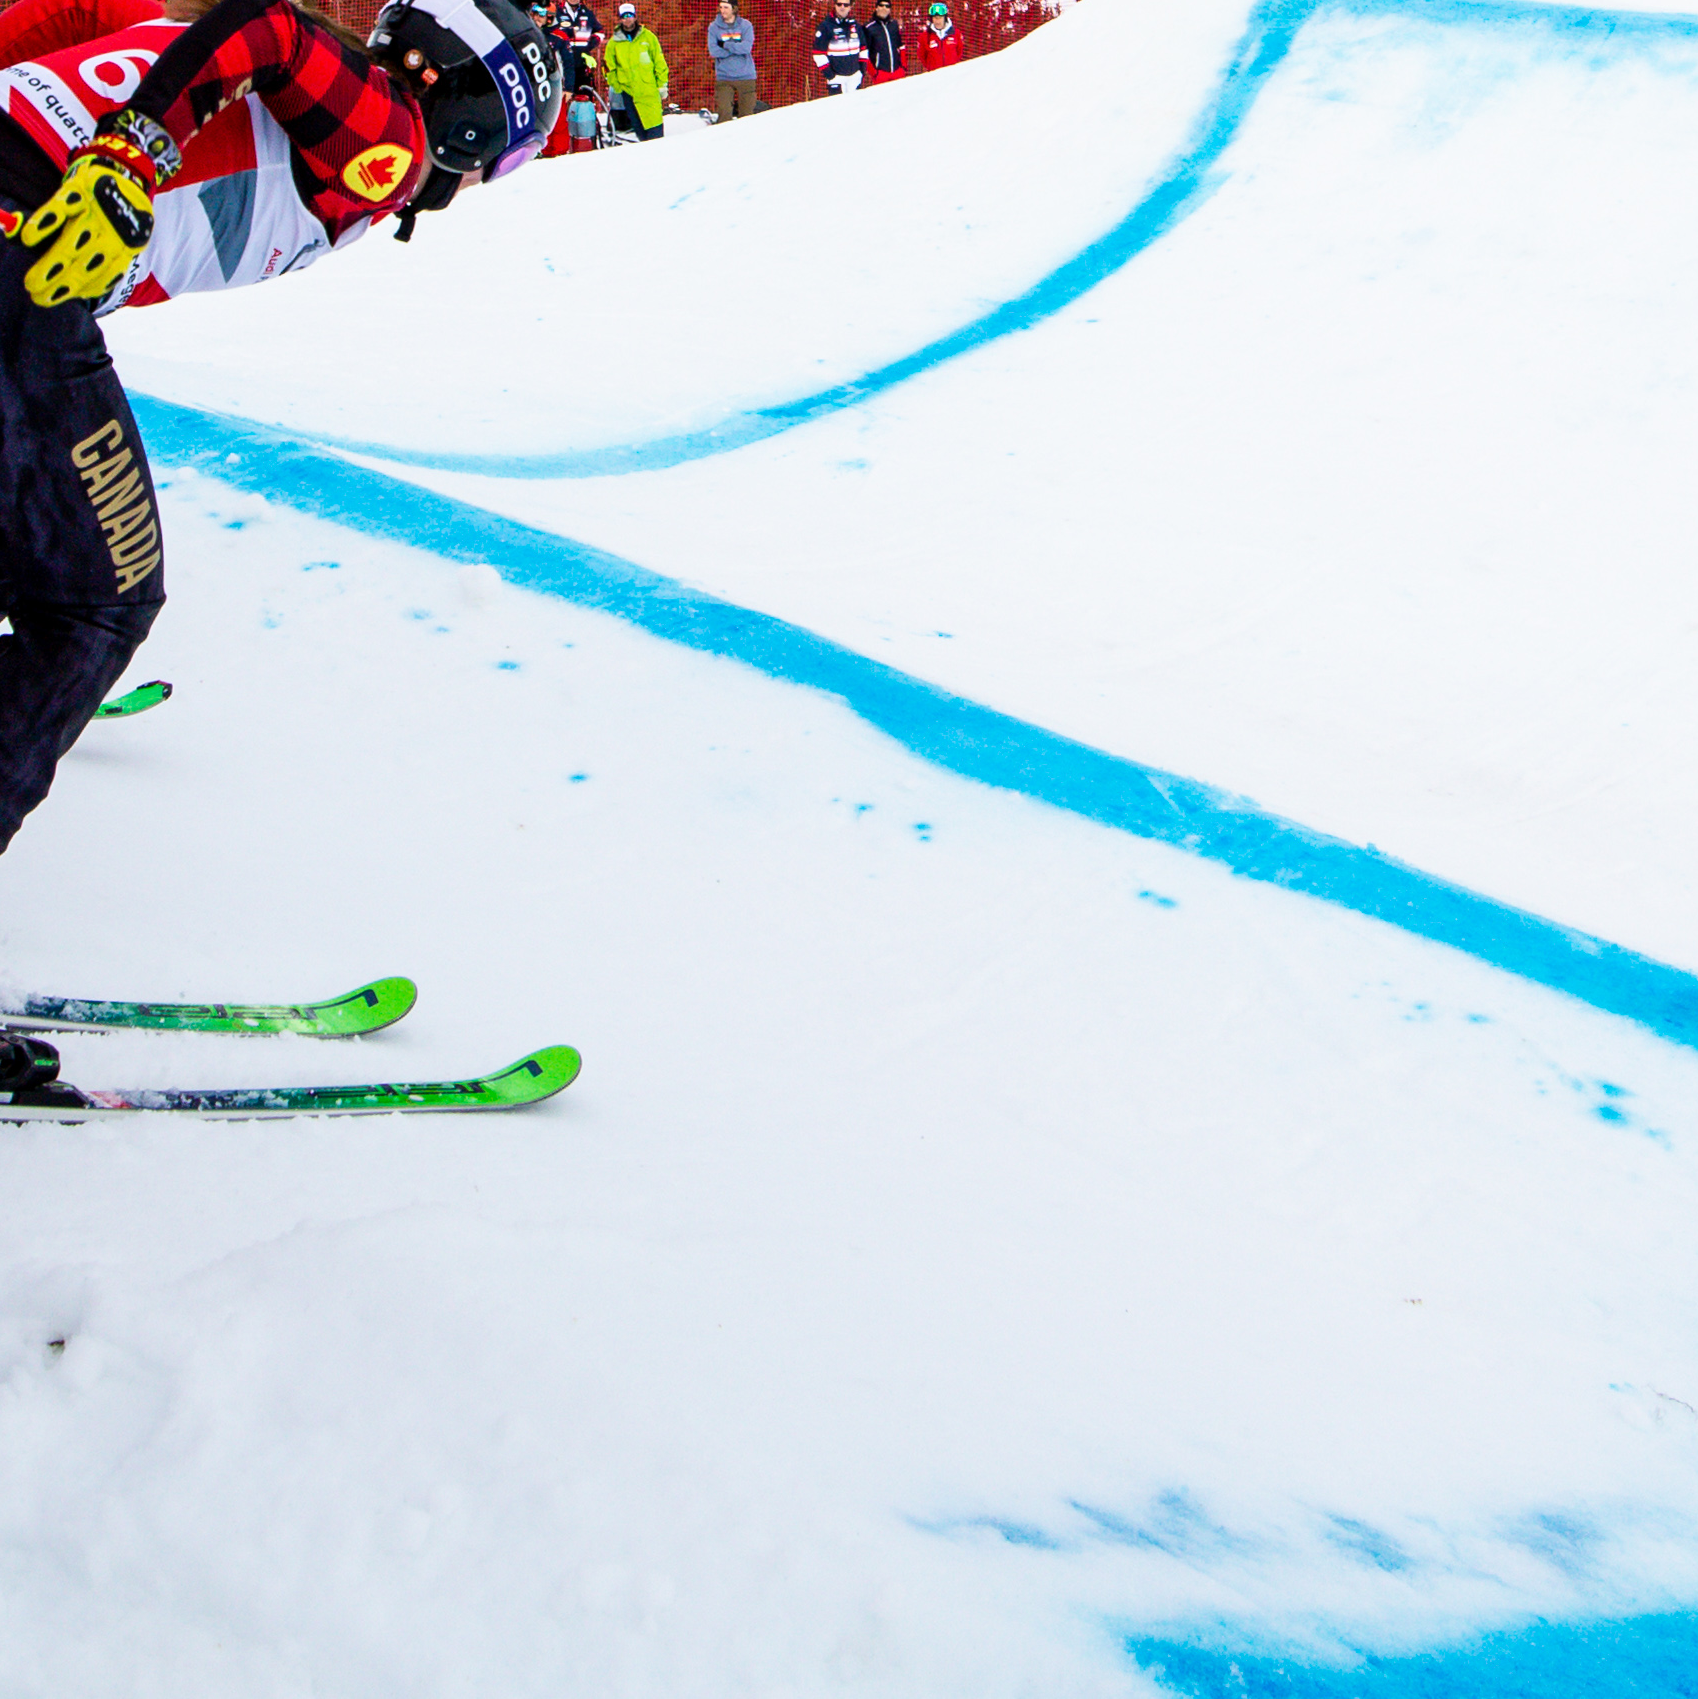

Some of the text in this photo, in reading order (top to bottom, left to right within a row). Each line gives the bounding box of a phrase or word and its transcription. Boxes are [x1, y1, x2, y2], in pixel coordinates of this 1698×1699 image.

[28, 76, 52, 93] of
[45, 91, 92, 148] quatt
[78, 49, 161, 104] 6
[70, 418, 161, 596] CANADA
